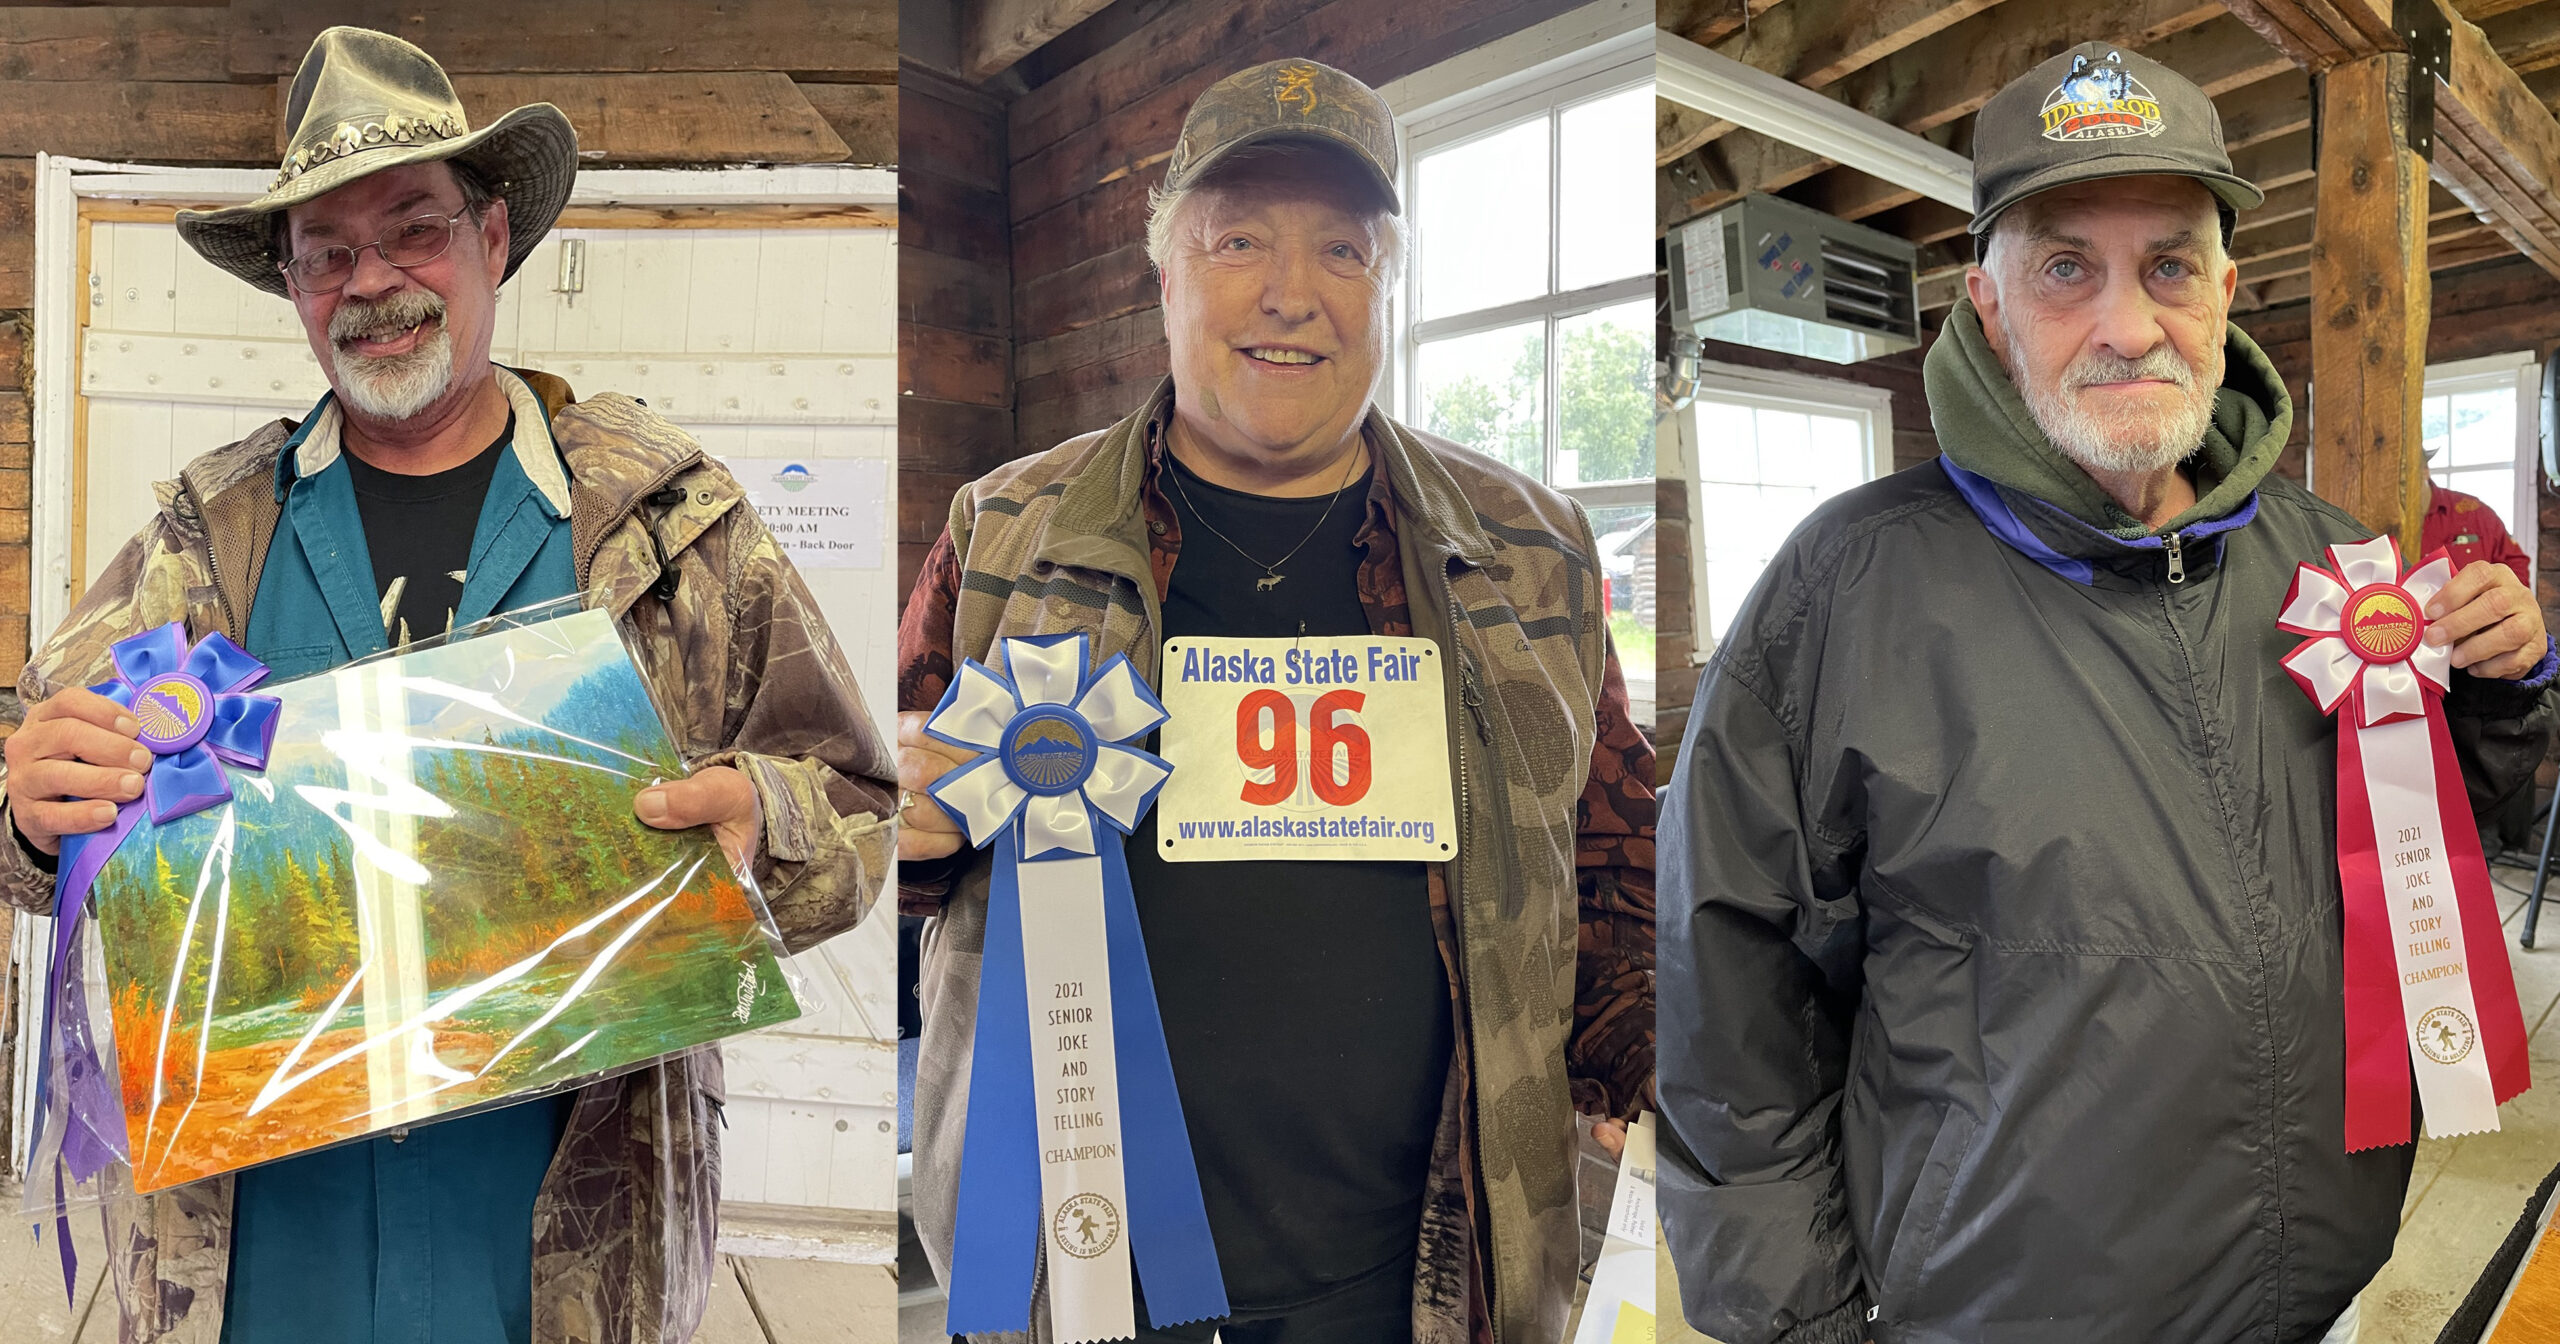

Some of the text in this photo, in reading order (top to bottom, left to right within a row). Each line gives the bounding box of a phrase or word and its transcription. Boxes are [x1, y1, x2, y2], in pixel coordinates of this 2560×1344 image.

[2041, 98, 2161, 133] IDITAROD
[2064, 112, 2142, 134] 2000
[2075, 126, 2136, 139] ALASKA
[755, 505, 850, 517] ETY MEETING
[764, 522, 818, 533] 0:00 AM
[800, 540, 826, 550] Back
[828, 540, 855, 550] Door
[1181, 646, 1421, 685] Alaska State Fair
[1236, 688, 1372, 807] 96
[1179, 815, 1436, 844] www.alaskastatefair.org
[2398, 826, 2422, 843] 2021
[2394, 847, 2431, 868] SENIOR
[2405, 871, 2431, 890] JOKE
[2412, 895, 2434, 911] AND
[2409, 916, 2442, 935] STORY
[2408, 937, 2451, 957] TELLING
[2404, 962, 2463, 986] CHAMPION
[1055, 982, 1083, 999] 2021
[1048, 1007, 1093, 1026] SENIOR
[2436, 1010, 2455, 1018] STATE
[1057, 1034, 1089, 1051] JOKE
[1062, 1061, 1088, 1078] AND
[1057, 1086, 1096, 1104] STORY
[1054, 1112, 1104, 1131] TELLING
[1045, 1143, 1116, 1164] CHAMPION
[1059, 1197, 1114, 1223] ALASKA STATE FAIR
[1059, 1234, 1079, 1253] SEEING
[1088, 1228, 1115, 1254] BELIEVING
